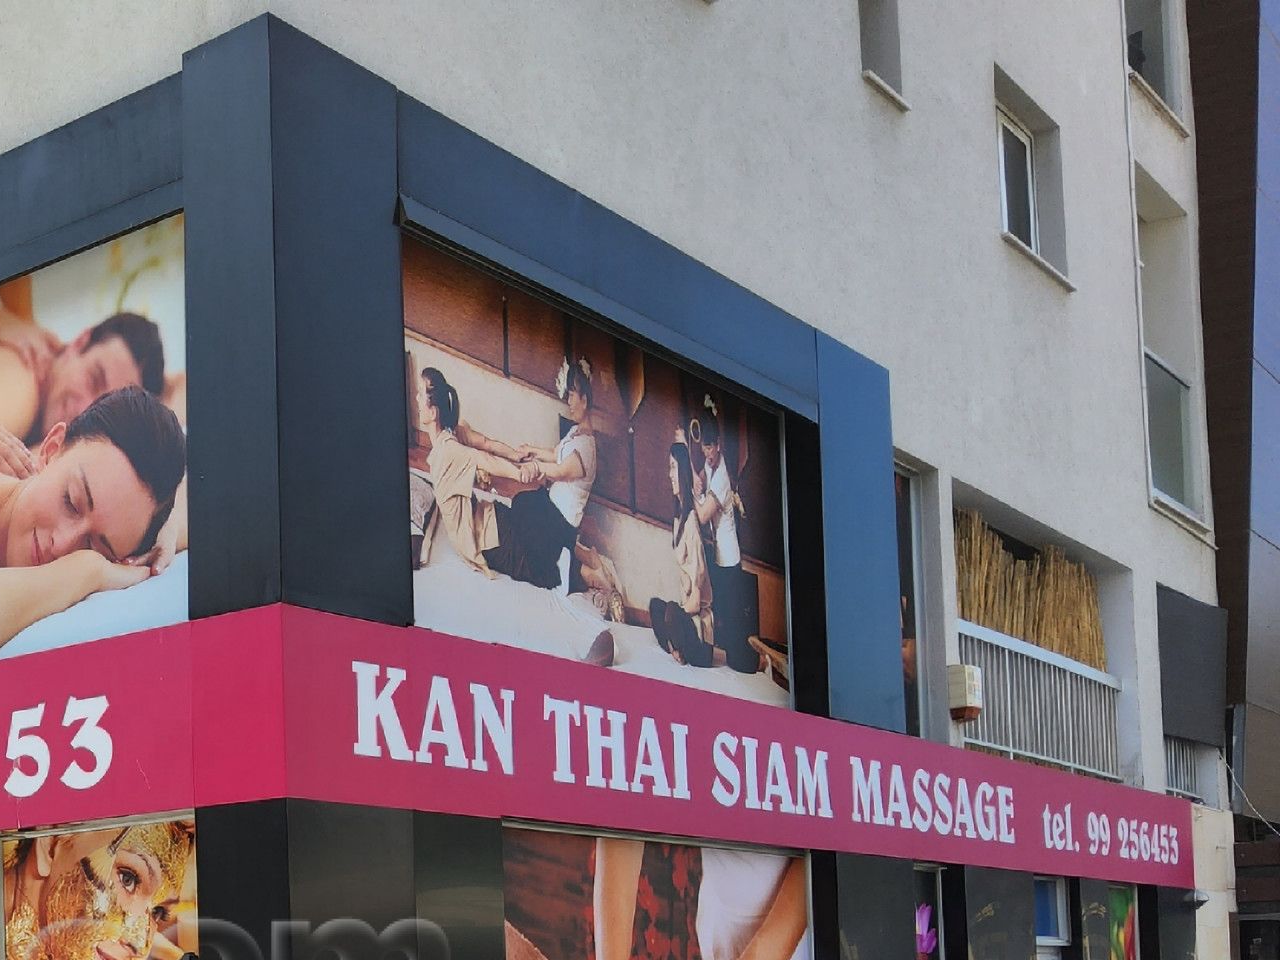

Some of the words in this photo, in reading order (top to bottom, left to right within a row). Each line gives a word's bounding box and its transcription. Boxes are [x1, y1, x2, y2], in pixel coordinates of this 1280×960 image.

[352, 661, 515, 775] KAN
[544, 694, 690, 800] THAI
[711, 731, 833, 818] SIAM
[849, 756, 1015, 844] MASSAGE
[1043, 803, 1080, 852] tel.
[1087, 812, 1111, 856] 99
[1117, 817, 1179, 865] 256453
